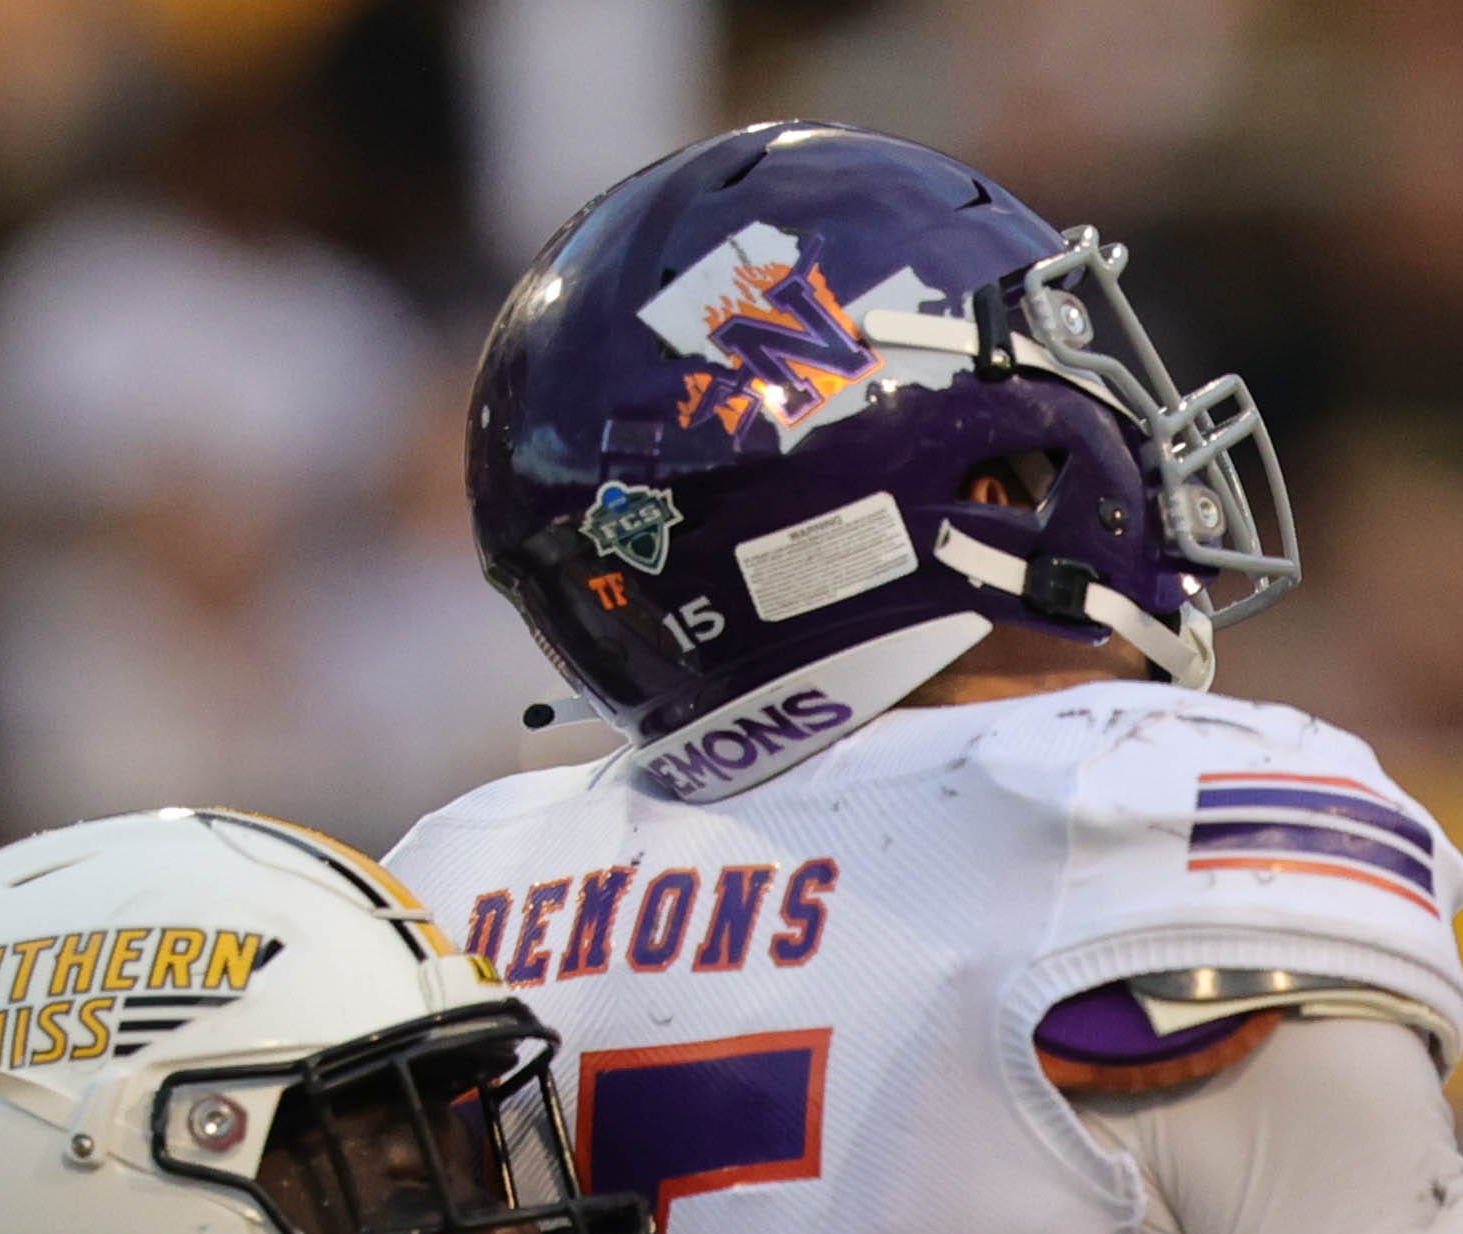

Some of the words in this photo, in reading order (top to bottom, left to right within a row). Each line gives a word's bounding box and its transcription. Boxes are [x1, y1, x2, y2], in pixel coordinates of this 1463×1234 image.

[588, 571, 628, 611] TF
[662, 596, 725, 653] 15
[640, 688, 854, 800] EMONS
[463, 856, 840, 990] DEMONS
